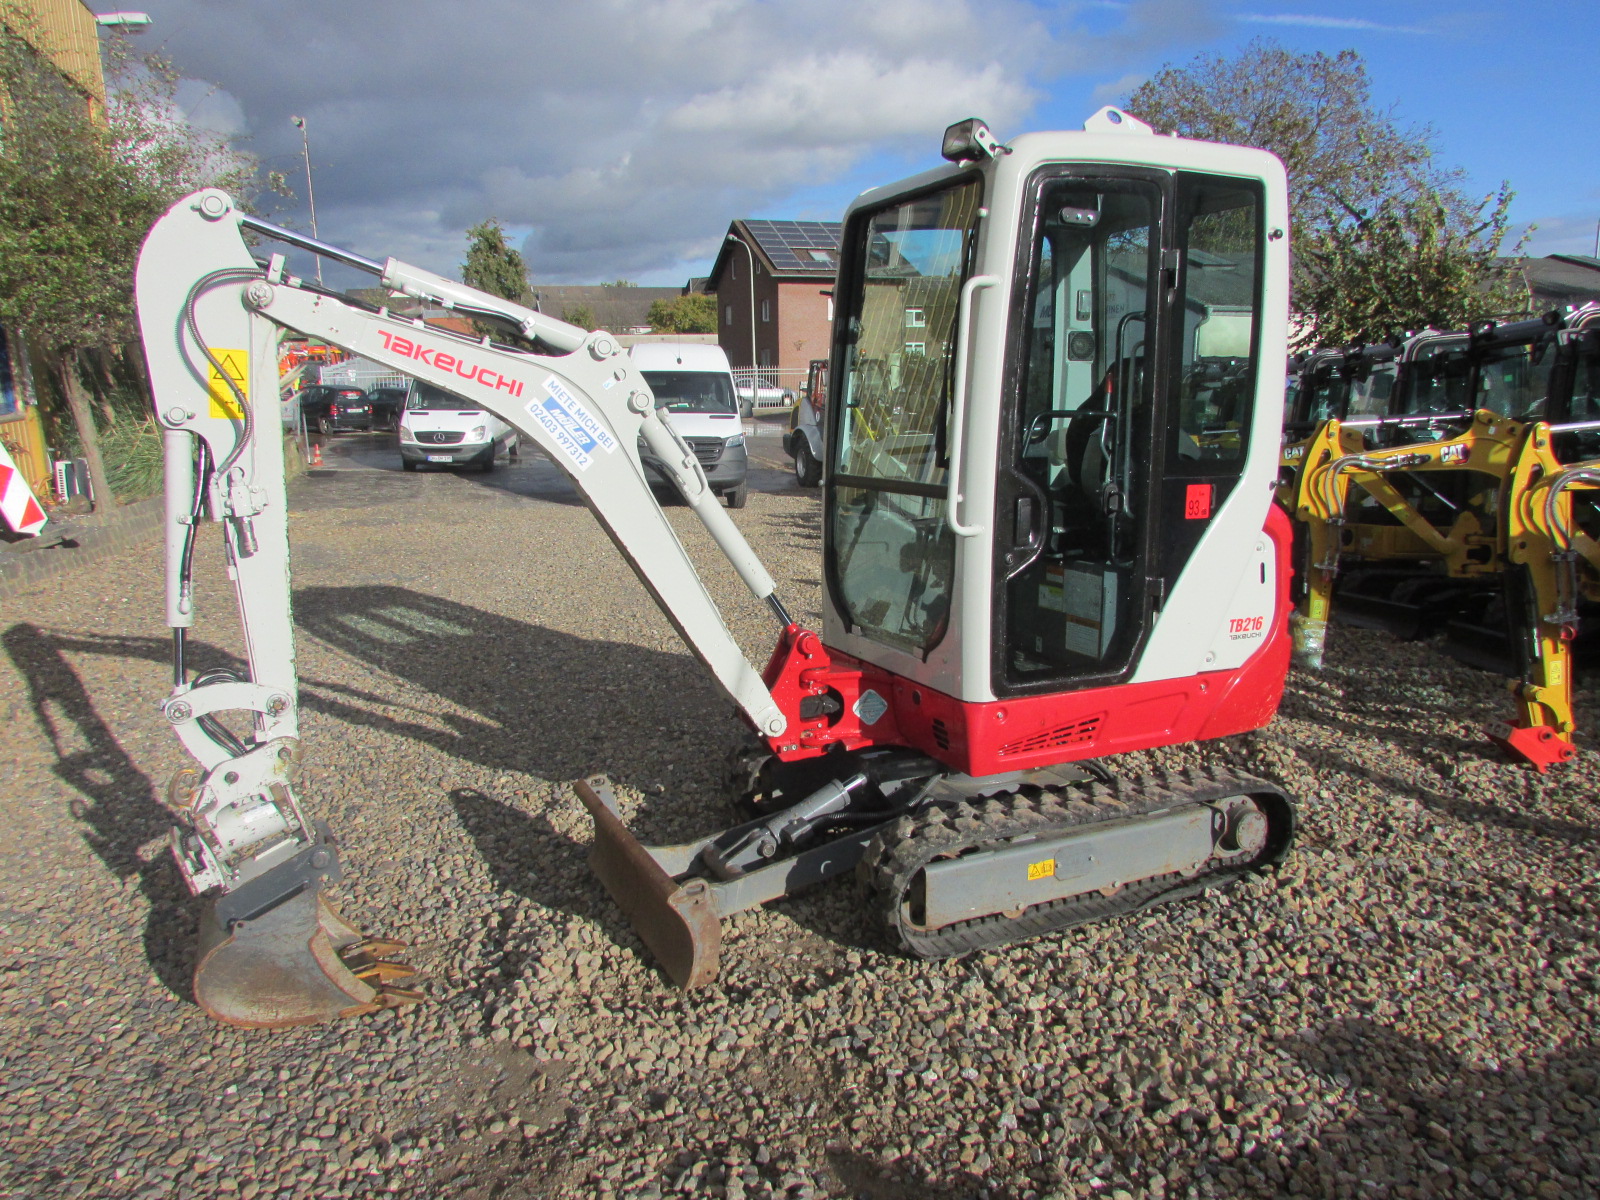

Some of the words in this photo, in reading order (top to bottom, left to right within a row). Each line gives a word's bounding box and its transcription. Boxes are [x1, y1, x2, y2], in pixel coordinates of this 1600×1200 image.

[377, 329, 524, 397] TAKEUCHI
[547, 380, 577, 411] MIETE
[574, 407, 600, 434] MICH
[597, 431, 614, 449] BEI
[529, 403, 558, 434] 02403
[556, 431, 588, 466] 997312
[1284, 446, 1304, 460] CAT
[1440, 444, 1465, 462] CAT
[1188, 499, 1200, 516] 93
[1229, 615, 1264, 633] TB216
[1229, 631, 1262, 641] TAKEUCHI
